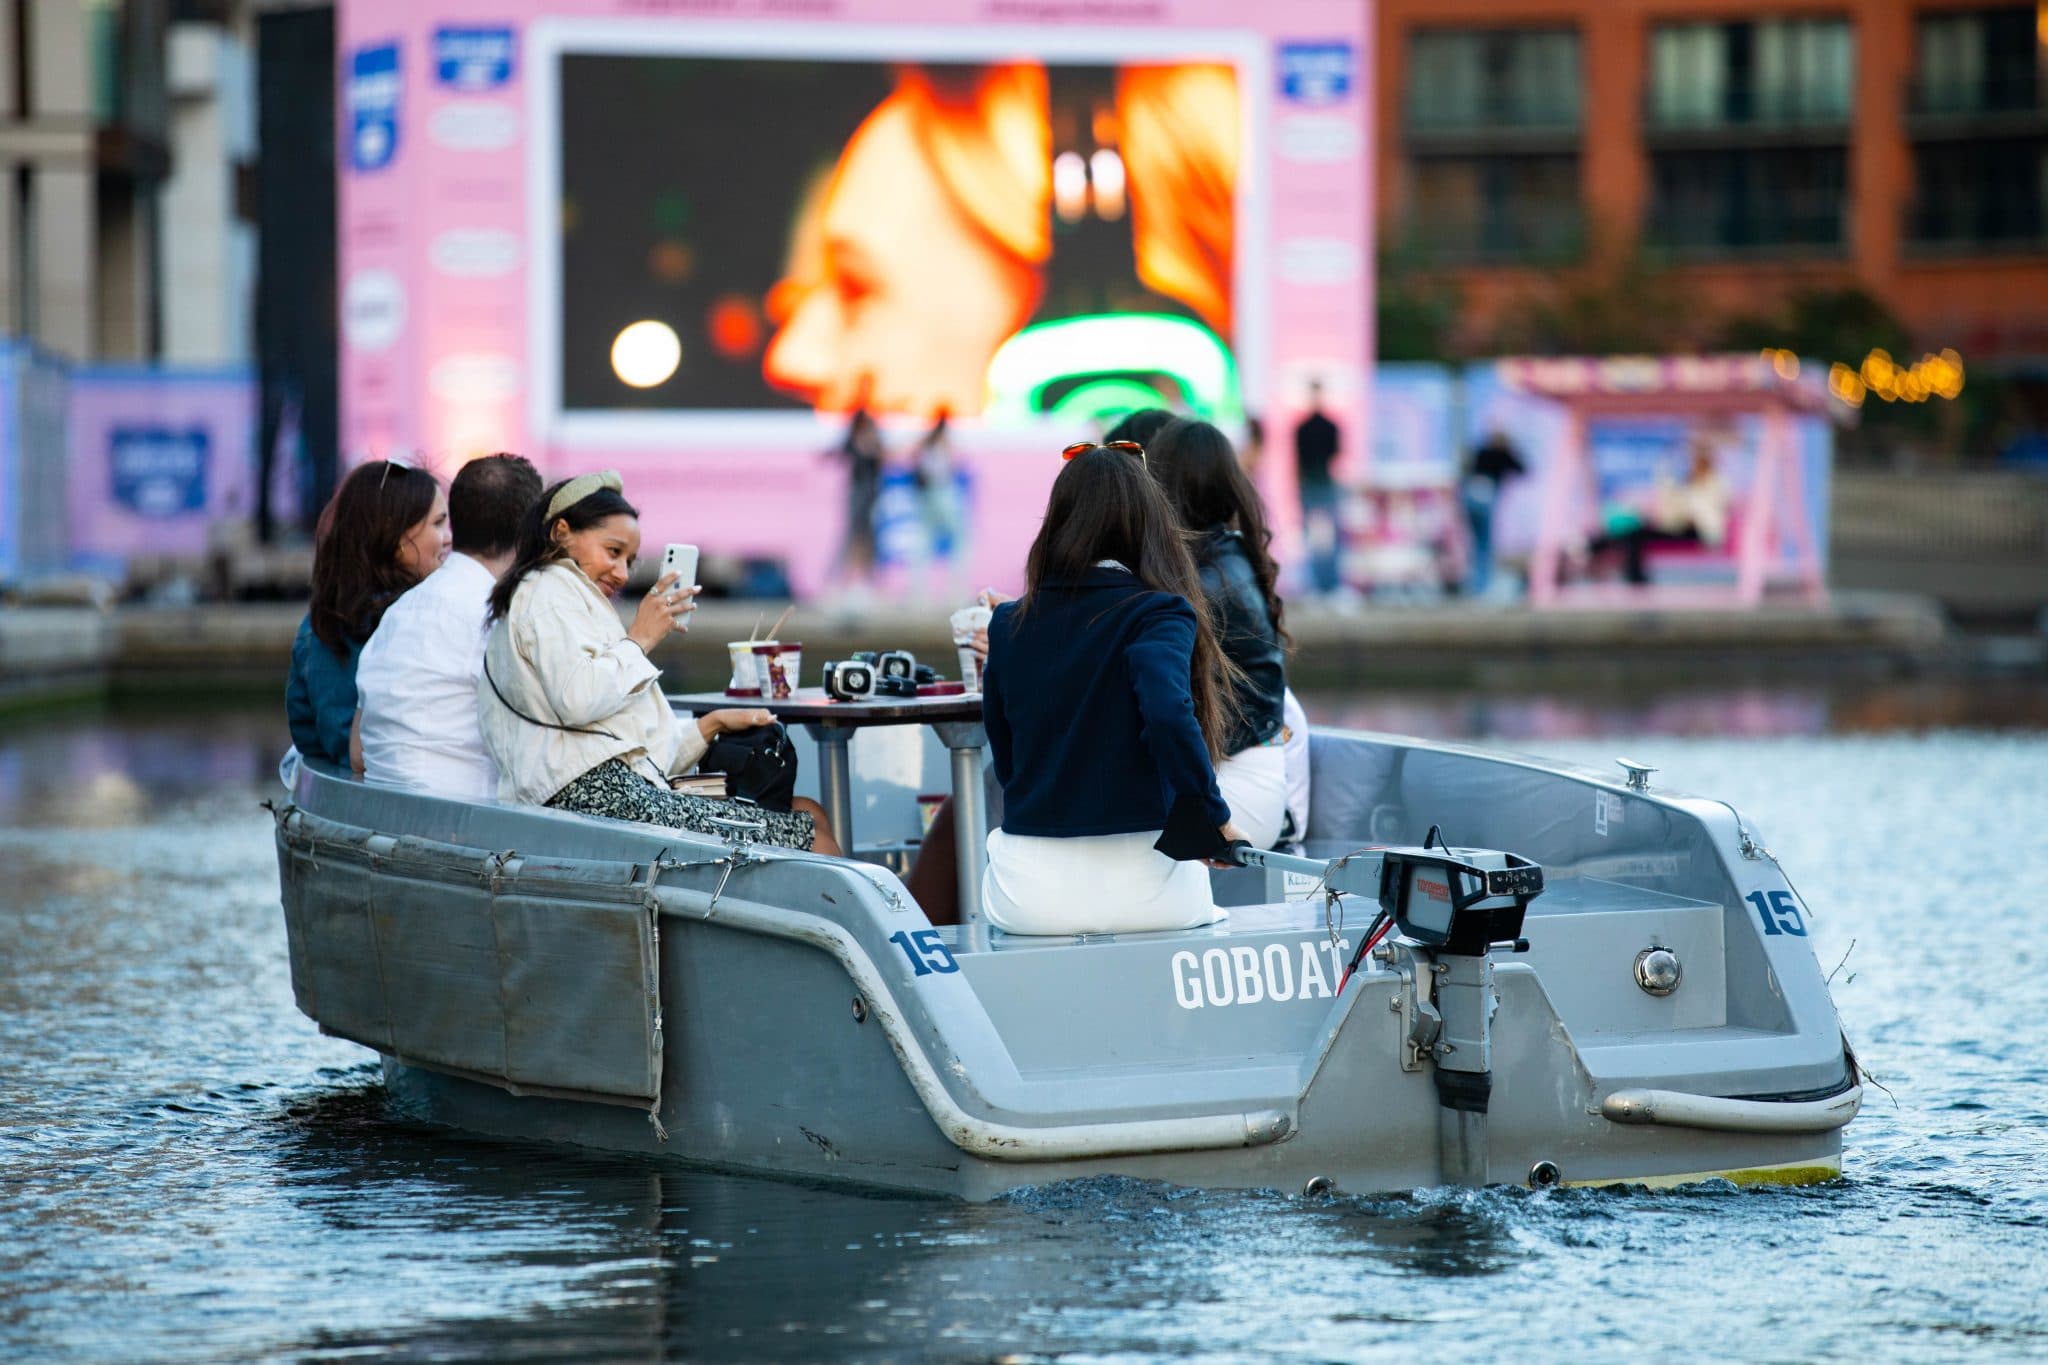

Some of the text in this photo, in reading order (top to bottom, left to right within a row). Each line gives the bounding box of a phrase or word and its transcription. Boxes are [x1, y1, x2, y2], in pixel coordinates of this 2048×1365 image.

[1745, 890, 1808, 936] 15
[889, 929, 960, 976] 15
[1171, 939, 1350, 1010] GOBOAT
